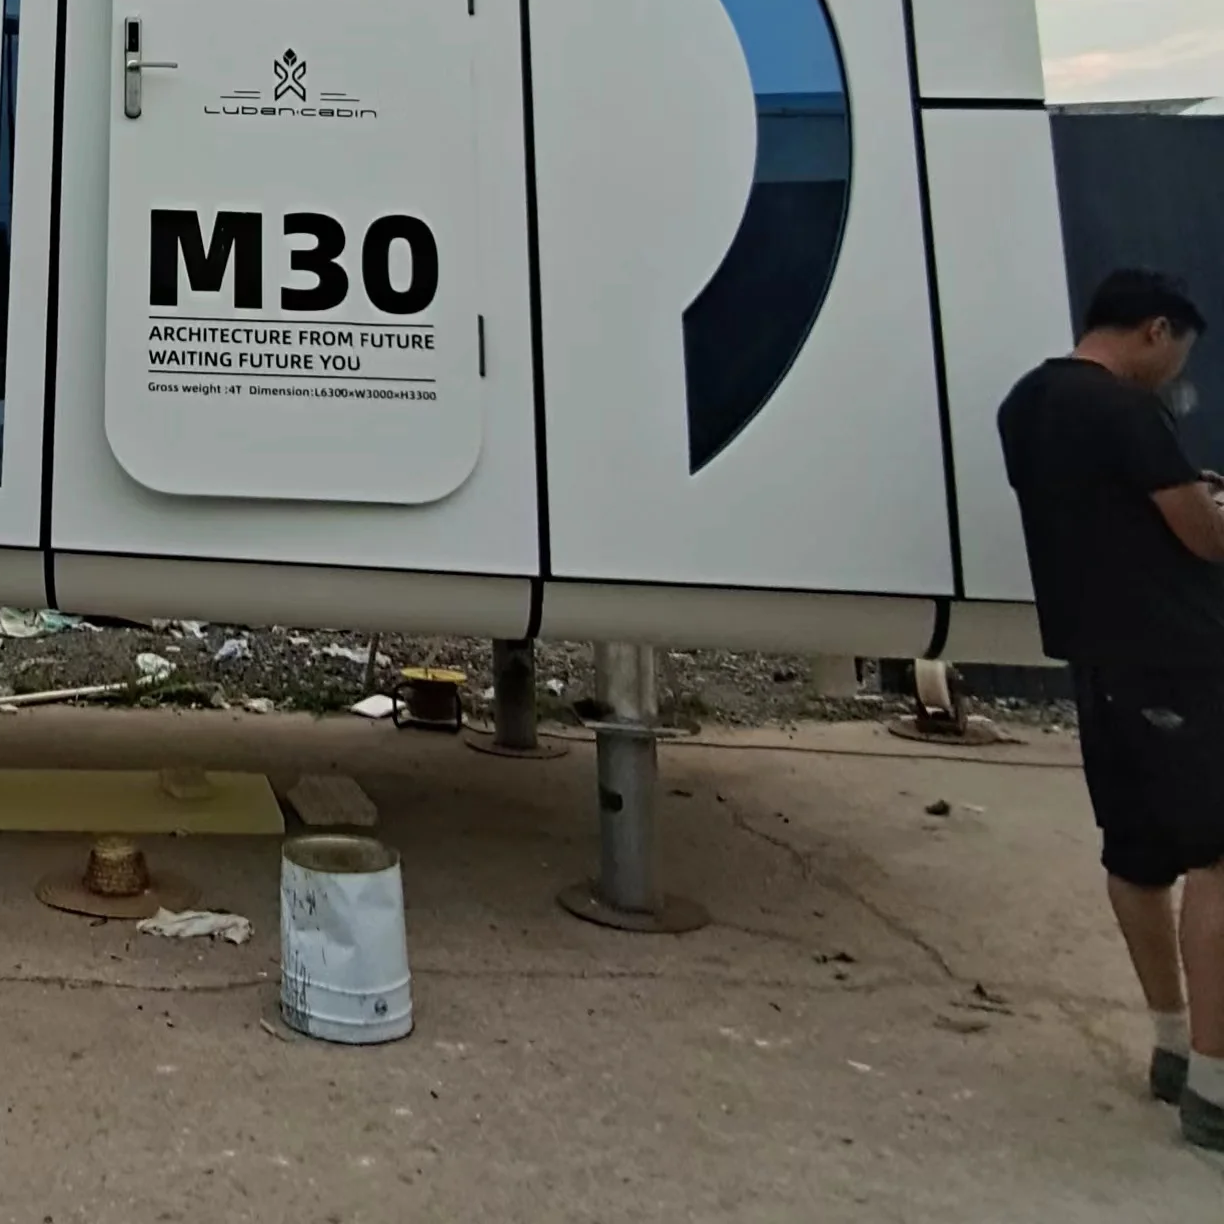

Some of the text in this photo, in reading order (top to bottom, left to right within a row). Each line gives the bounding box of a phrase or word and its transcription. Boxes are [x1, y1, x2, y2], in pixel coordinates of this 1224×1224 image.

[149, 208, 440, 316] M30
[148, 325, 436, 351] ARCHITECTURE FROM FUTURE
[148, 349, 362, 372] WAITING FUTURE YOU
[147, 381, 180, 393] Gross
[181, 383, 222, 396] weight
